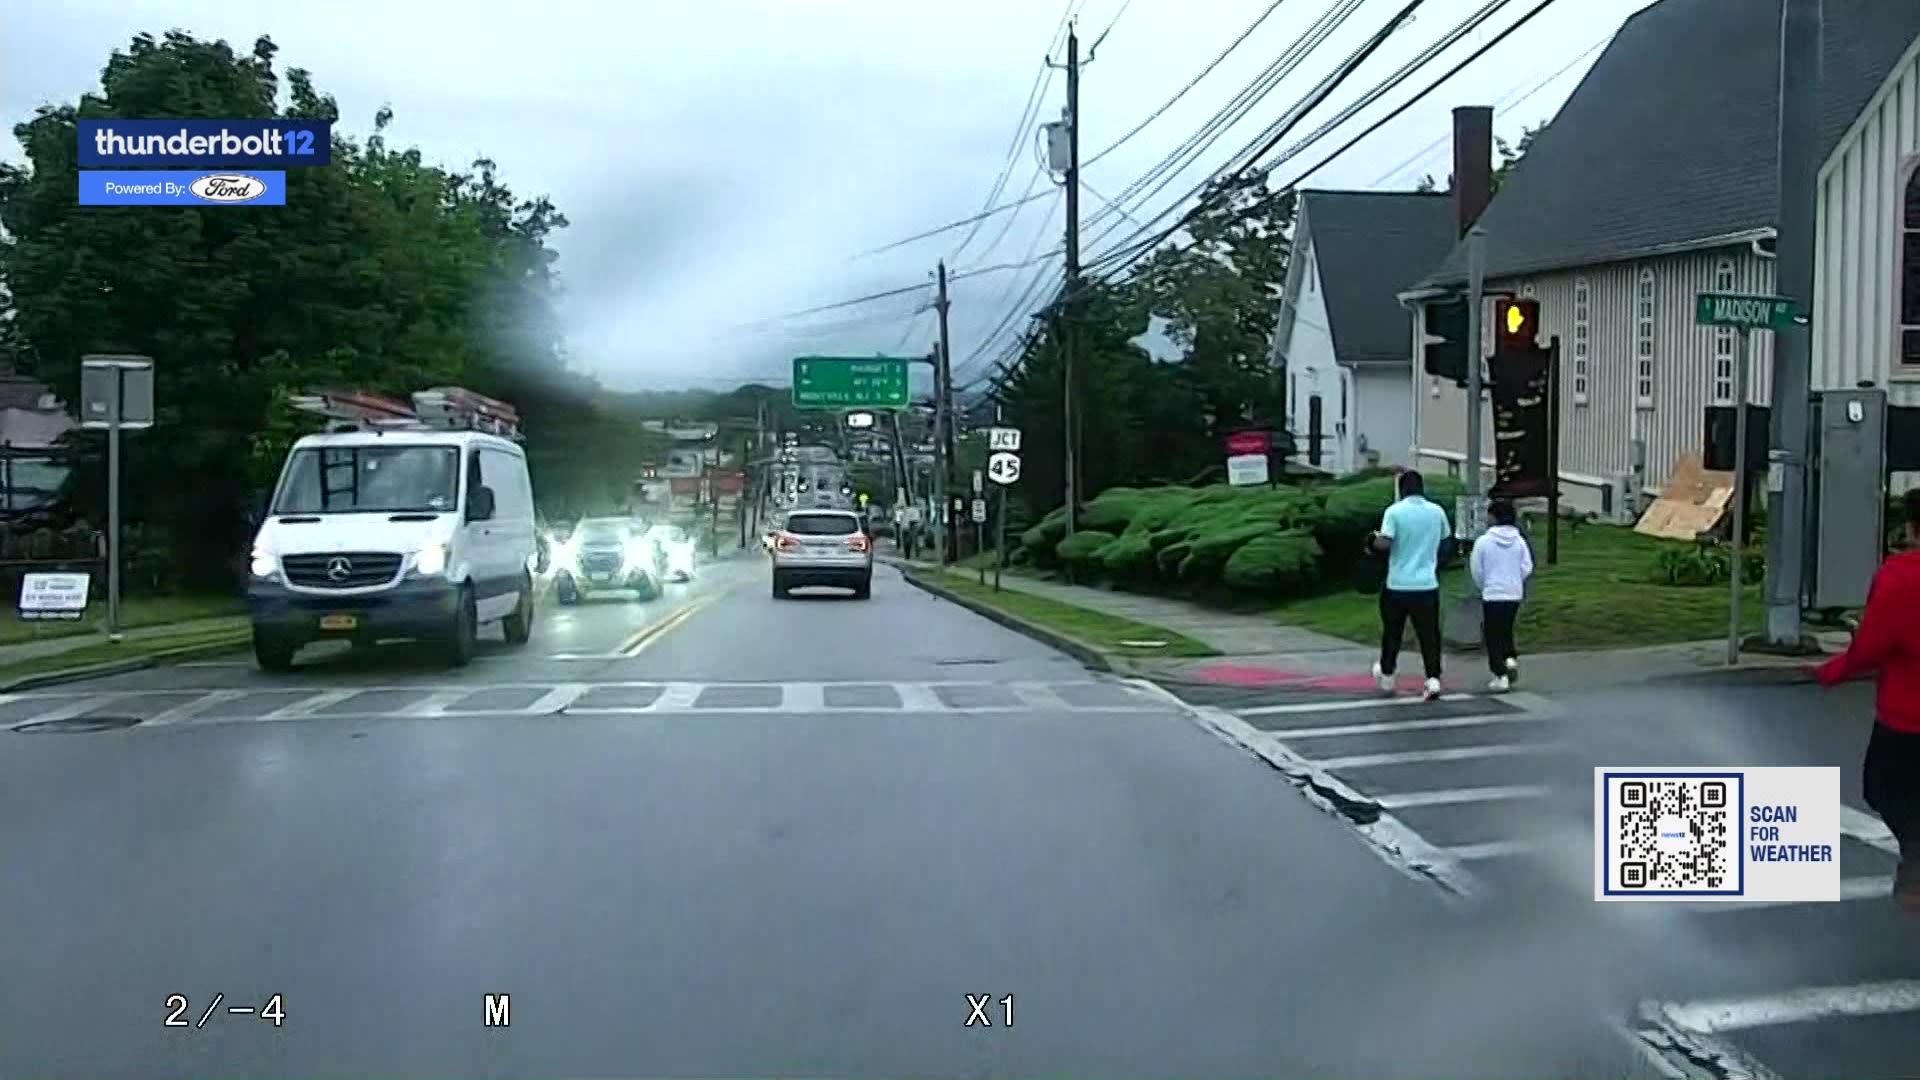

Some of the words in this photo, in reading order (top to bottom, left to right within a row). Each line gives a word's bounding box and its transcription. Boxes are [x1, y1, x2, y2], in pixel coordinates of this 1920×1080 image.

[1713, 298, 1771, 324] MADISON
[992, 432, 1017, 446] JCT
[992, 459, 1018, 478] 45
